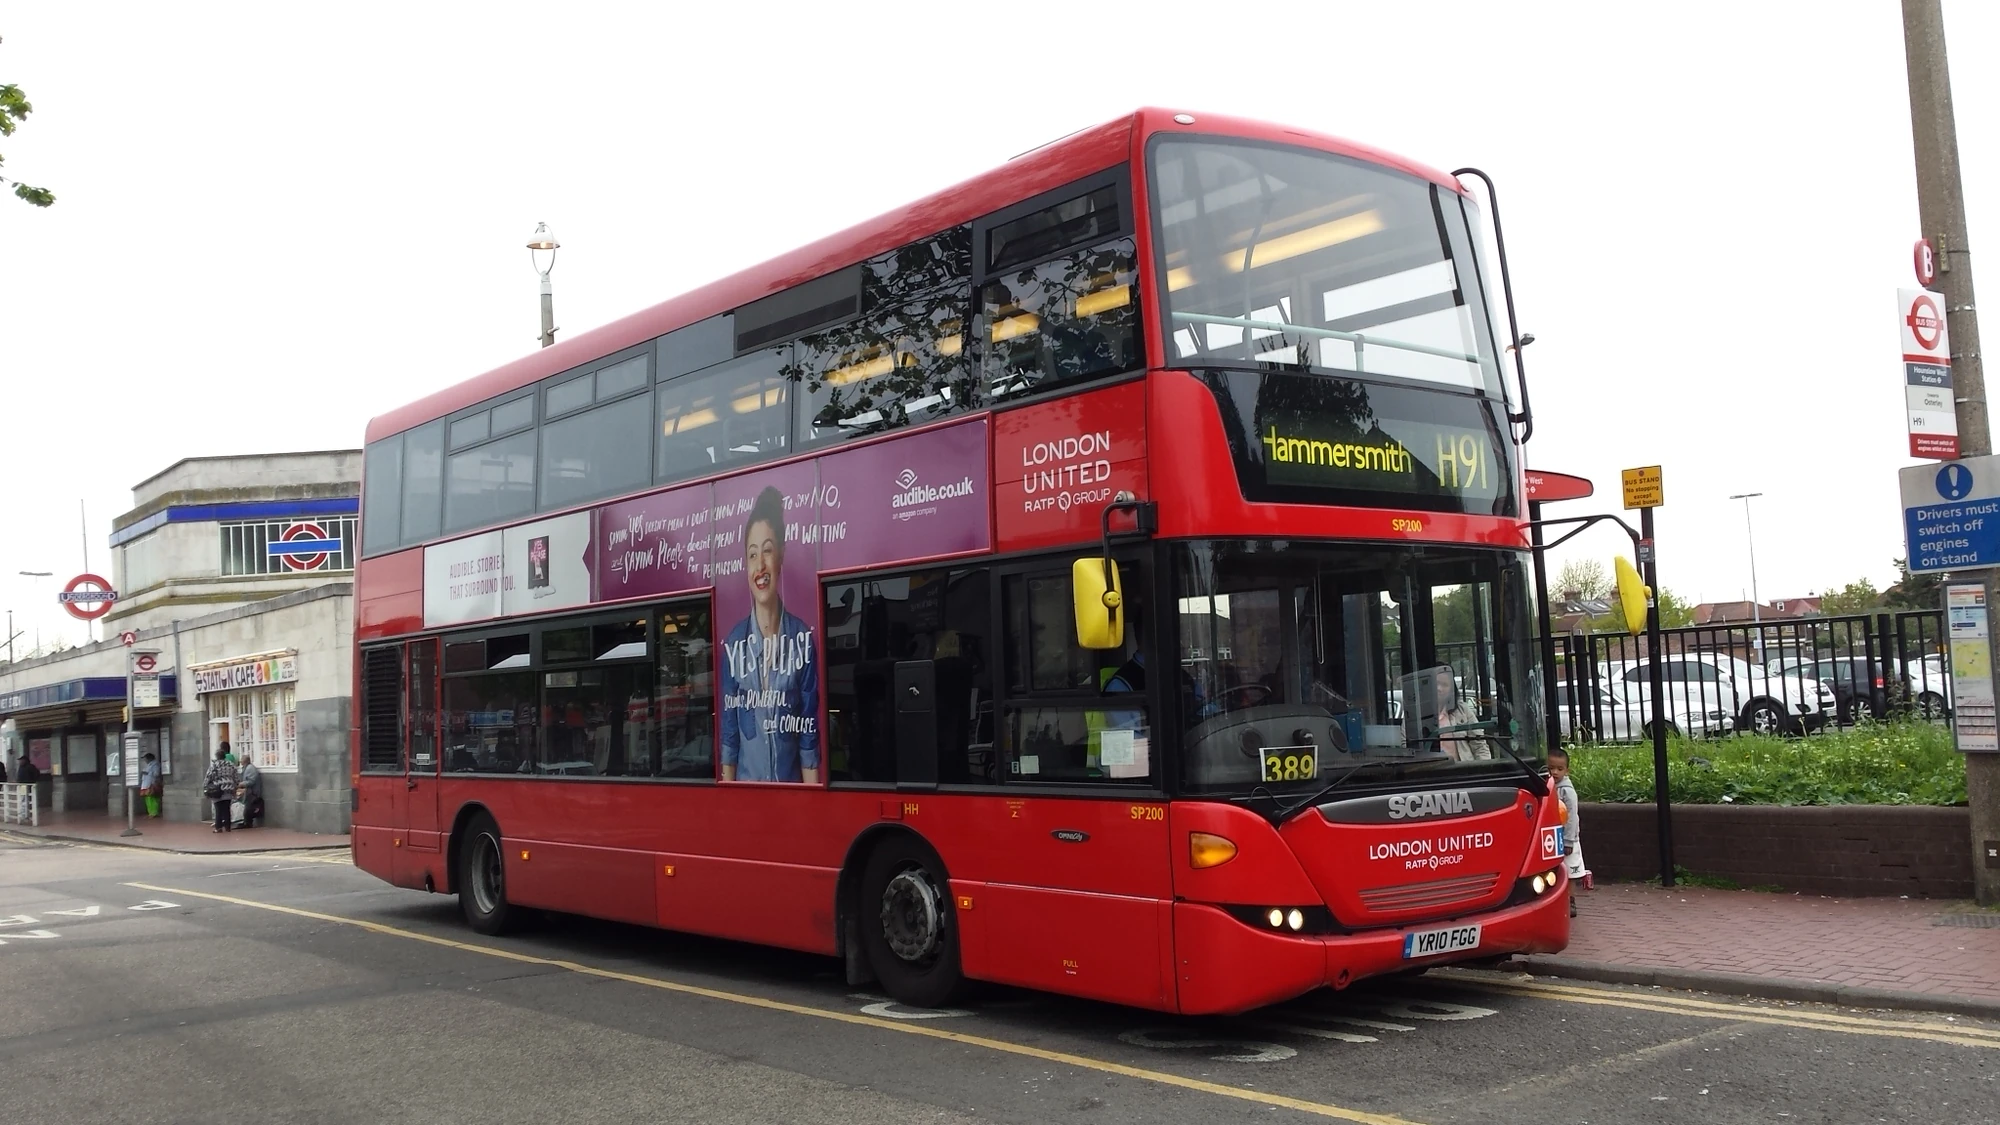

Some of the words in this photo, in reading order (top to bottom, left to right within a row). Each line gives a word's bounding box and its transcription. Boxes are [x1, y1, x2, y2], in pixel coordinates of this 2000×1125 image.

[1923, 245, 1934, 278] B
[1915, 317, 1926, 326] BUS
[1926, 318, 1937, 328] STOP
[1914, 366, 1936, 375] Hounslow
[1937, 368, 1947, 377] West
[1921, 374, 1937, 383] Station
[1924, 398, 1943, 408] Osterley
[1913, 417, 1925, 426] H91
[1023, 430, 1110, 467] LONDON
[1263, 426, 1412, 473] Hammersmith
[1437, 433, 1487, 489] H91
[1023, 459, 1111, 494] UNITED
[1530, 477, 1544, 485] West
[1639, 476, 1660, 484] STAND
[892, 476, 974, 509] audible.co.uk
[1633, 492, 1652, 500] except
[1635, 485, 1659, 493] stopping
[1024, 497, 1055, 513] RATP
[1072, 488, 1111, 505] GROUP
[667, 517, 684, 532] MEAN
[686, 515, 690, 526] I
[782, 495, 793, 510] TO
[795, 492, 810, 508] SAY
[898, 509, 916, 521] amazon
[916, 506, 937, 517] company
[1917, 509, 1962, 521] Drivers
[1965, 502, 1999, 516] must
[1392, 518, 1423, 533] SP200
[1918, 522, 1960, 536] switch
[1963, 519, 1984, 532] off
[622, 547, 654, 584] SAYING
[713, 530, 735, 549] MEAN
[738, 524, 742, 543] I
[784, 522, 799, 542] AM
[802, 521, 847, 545] WAITING
[1920, 538, 1969, 552] engines
[1921, 557, 1938, 567] on
[1941, 551, 1978, 563] stand
[449, 560, 476, 579] AUDIBLE.
[702, 557, 745, 580] PERMISSION.
[449, 583, 463, 600] THAT
[464, 577, 498, 597] SURROUND
[501, 575, 516, 592] OU.
[60, 591, 117, 602] UNDERGROUND
[124, 634, 133, 643] A
[235, 665, 255, 686] CAFE
[763, 715, 777, 734] and
[779, 714, 817, 734] CONCISE.
[1266, 754, 1314, 782] 389
[904, 803, 919, 815] HH
[1388, 791, 1473, 819] SCANIA
[1130, 806, 1164, 821] SP200
[1369, 839, 1432, 860] LONDON
[1438, 832, 1494, 852] UNITED
[1405, 859, 1428, 870] RATP
[1439, 855, 1464, 866] GROUP
[1418, 932, 1448, 952] YR10
[1450, 927, 1476, 948] FGG
[1062, 959, 1079, 968] PULL
